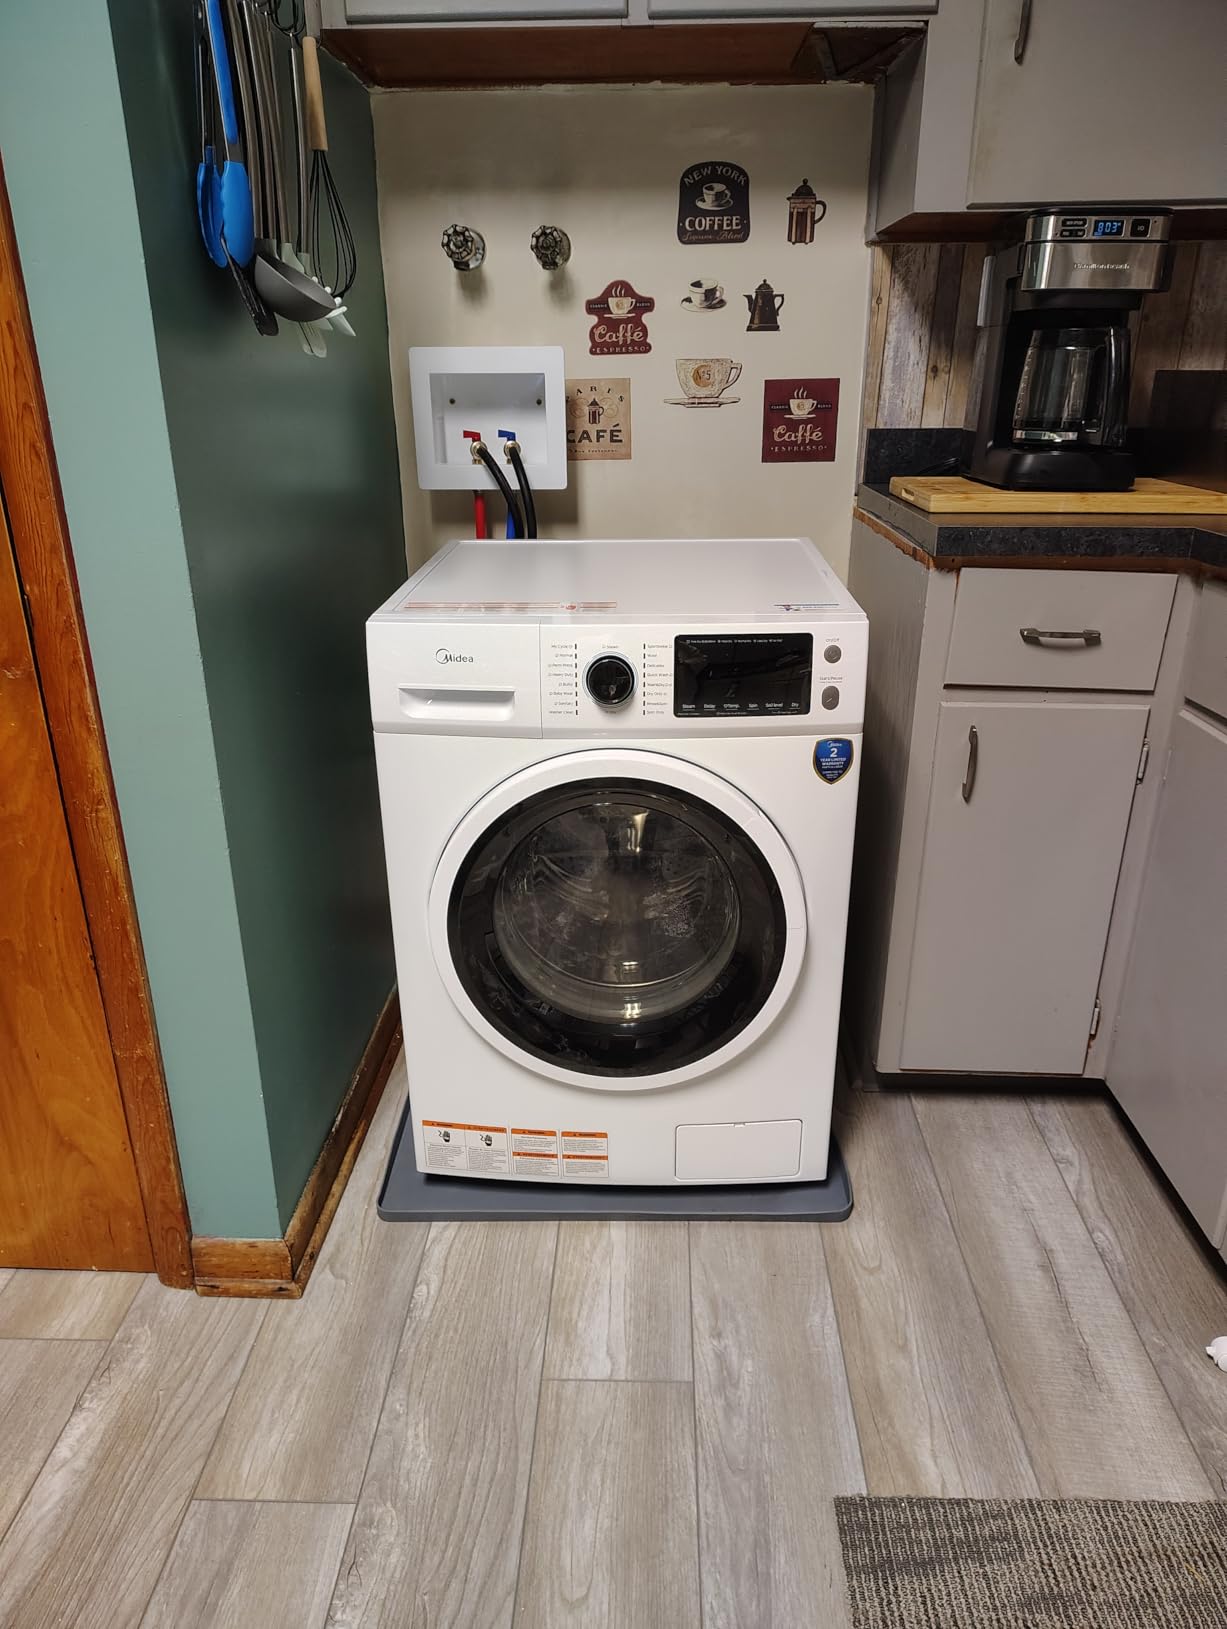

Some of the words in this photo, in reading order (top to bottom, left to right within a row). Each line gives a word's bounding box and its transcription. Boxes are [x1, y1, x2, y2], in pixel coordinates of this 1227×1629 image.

[684, 166, 712, 187] NEW
[715, 166, 747, 187] YORK
[685, 215, 742, 231] COFFEE
[593, 324, 645, 345] Caffé
[566, 423, 623, 443] CAFÉ
[772, 424, 824, 444] Caffé
[435, 648, 474, 664] Midea
[830, 747, 838, 758] 2
